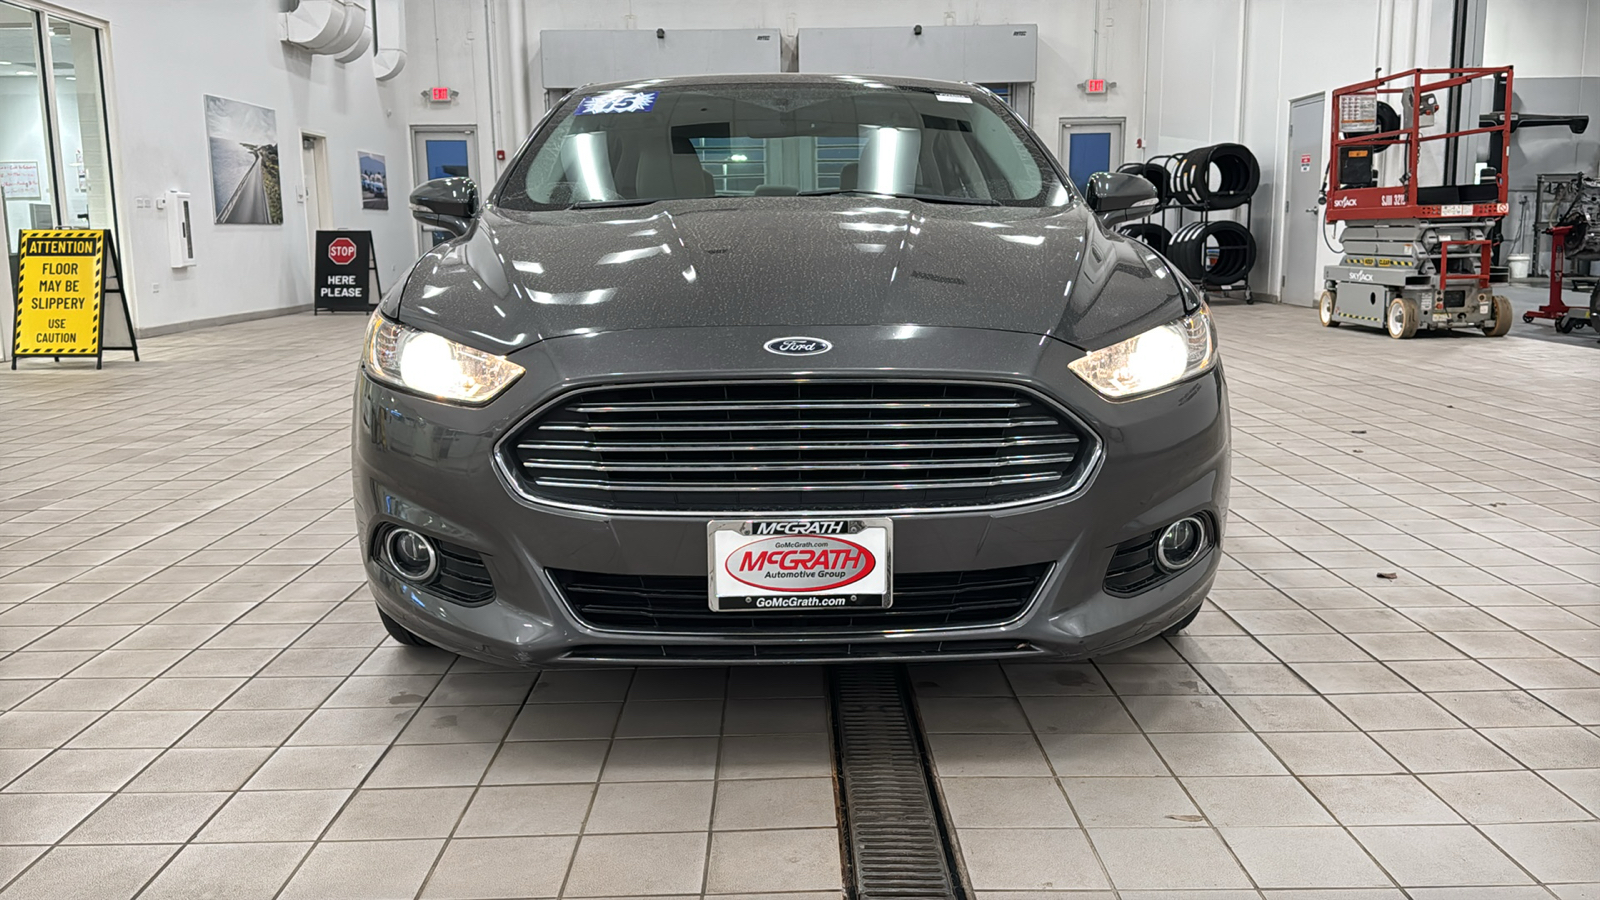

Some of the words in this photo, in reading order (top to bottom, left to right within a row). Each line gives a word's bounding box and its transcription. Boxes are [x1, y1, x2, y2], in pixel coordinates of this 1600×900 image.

[1089, 80, 1104, 91] EXIT
[433, 88, 448, 100] EXIT
[1334, 196, 1357, 208] SKYJACK
[29, 241, 93, 254] ATTENTION
[330, 246, 354, 256] STOP
[42, 263, 79, 275] FLOOR
[327, 275, 356, 285] HERE
[1349, 270, 1373, 281] SKYJACK
[39, 280, 62, 292] MAY
[65, 280, 79, 292] BE
[320, 287, 362, 297] PLEASE
[31, 297, 85, 309] SLIPPERY
[48, 319, 66, 329] USE
[36, 332, 77, 343] CAUTION
[779, 340, 816, 351] Ford
[775, 541, 828, 549] GoMcGrath.com
[764, 571, 816, 579] Automotive
[817, 570, 846, 579] Group
[756, 597, 846, 607] GoMcGrath.com
